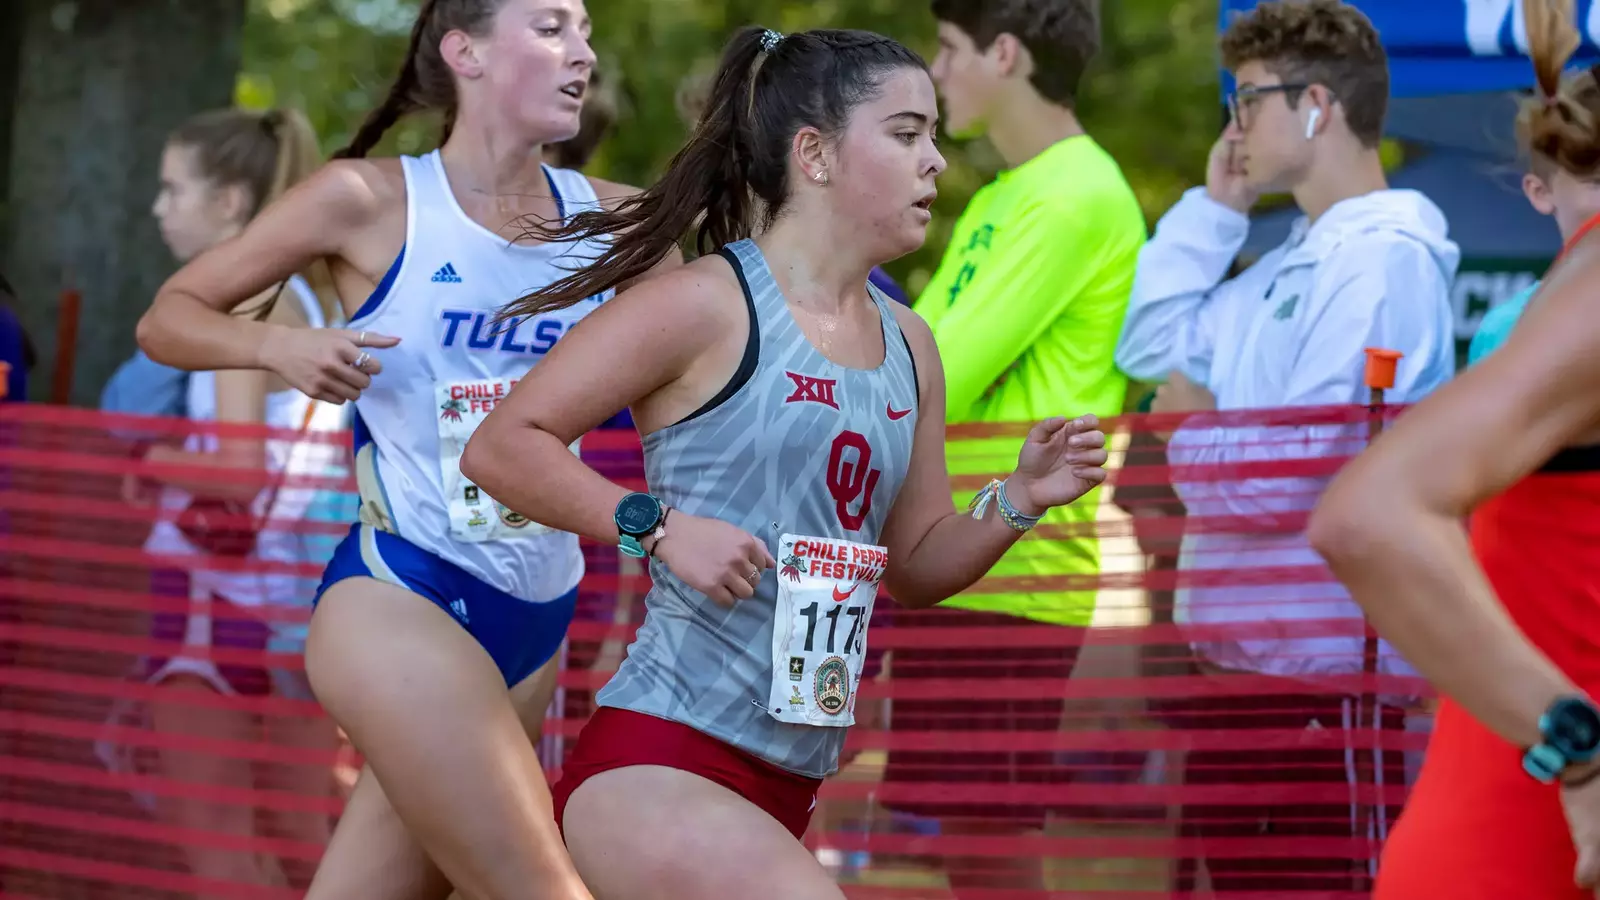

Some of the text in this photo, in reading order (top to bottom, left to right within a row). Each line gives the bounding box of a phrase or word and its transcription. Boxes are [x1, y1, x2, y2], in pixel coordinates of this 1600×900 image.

[442, 312, 577, 354] TULS
[451, 383, 504, 400] CHILE
[785, 371, 840, 411] XII
[826, 430, 881, 531] OU
[793, 540, 847, 561] CHILE
[809, 560, 879, 582] FESTIVAL
